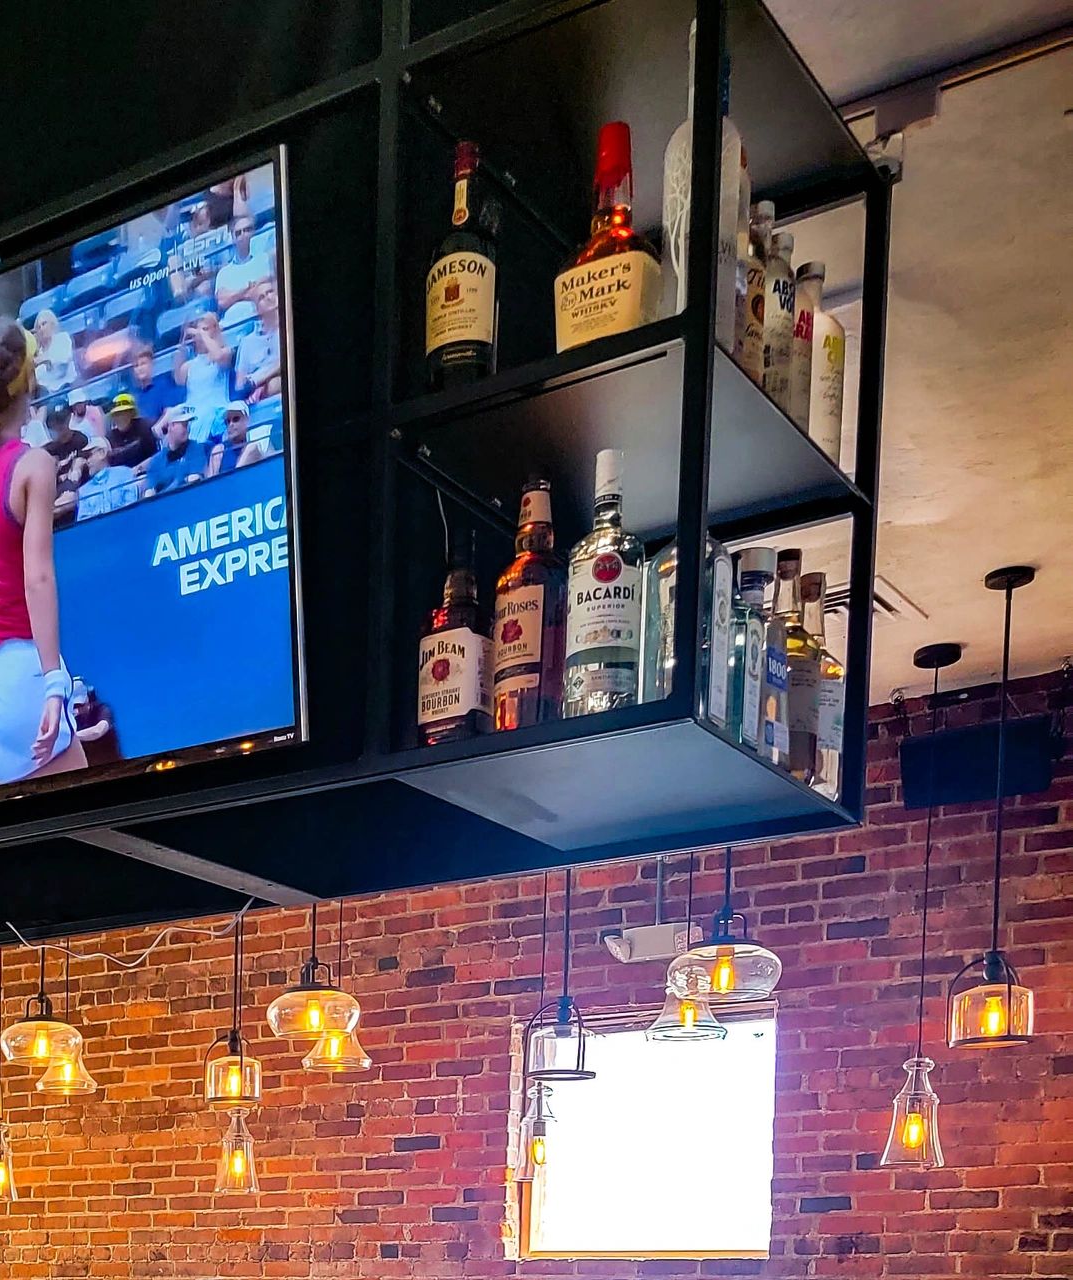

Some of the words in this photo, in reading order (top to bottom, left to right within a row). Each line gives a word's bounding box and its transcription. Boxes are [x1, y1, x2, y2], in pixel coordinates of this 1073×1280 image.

[143, 265, 170, 287] open
[427, 259, 487, 295] JAMESON
[560, 262, 631, 294] Maker's
[579, 279, 631, 303] Mark
[508, 599, 539, 617] Roses
[587, 604, 625, 612] SUPERIOR
[768, 657, 787, 680] 1800
[421, 693, 460, 713] BOURBON
[287, 732, 294, 740] TV
